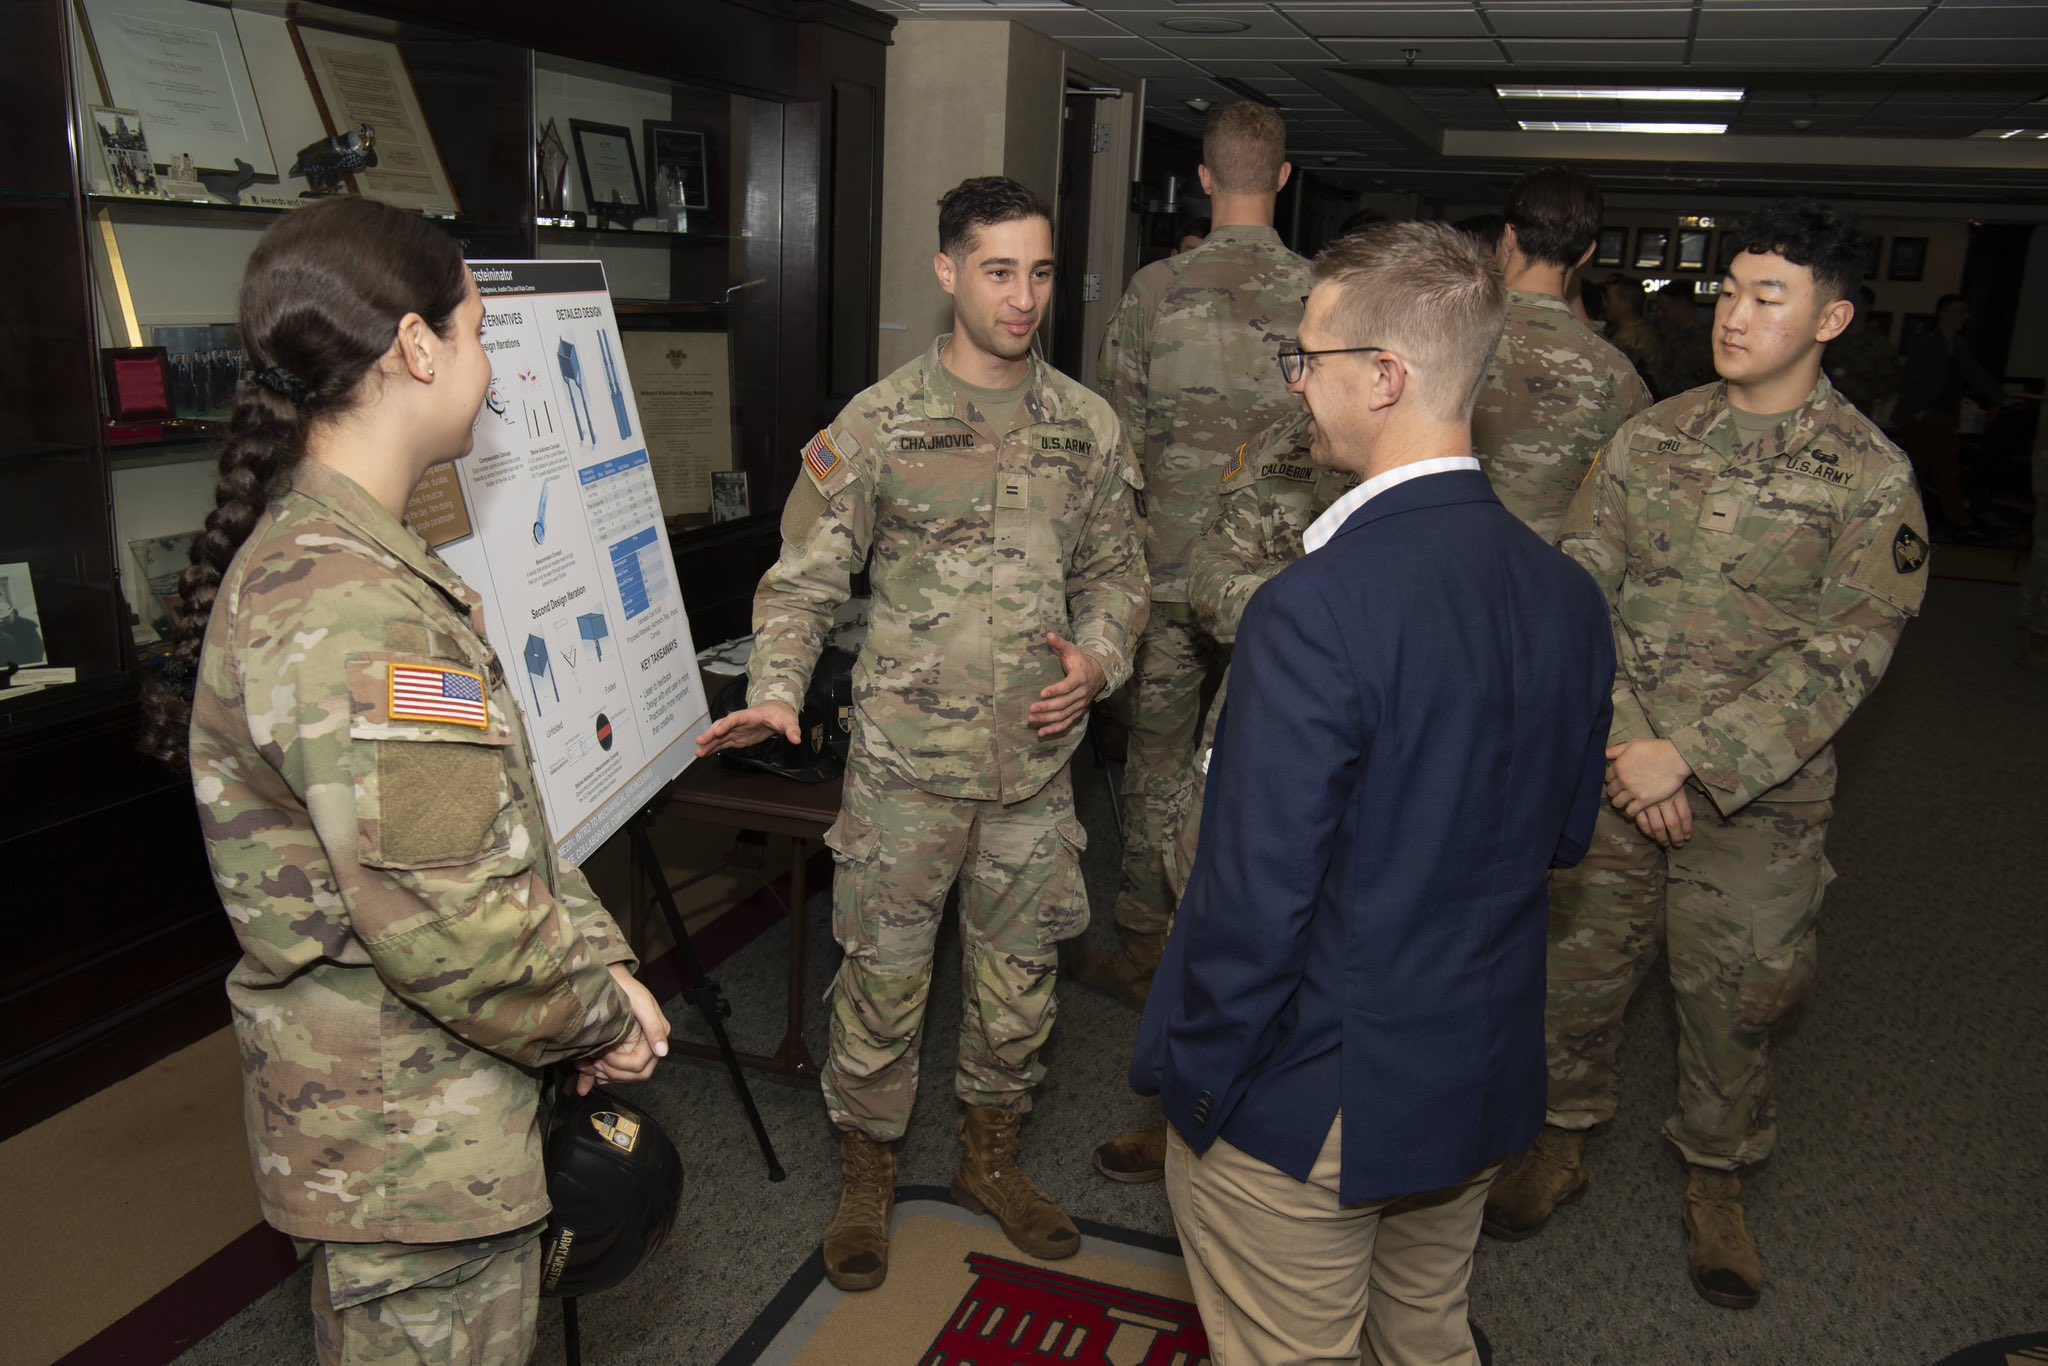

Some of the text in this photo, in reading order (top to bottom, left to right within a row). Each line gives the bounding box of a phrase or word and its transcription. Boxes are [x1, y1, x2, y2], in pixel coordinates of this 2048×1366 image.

[557, 307, 602, 320] DETAILED DESIGN
[496, 338, 520, 349] Iterations
[900, 433, 974, 450] CHAJMOVIC
[1041, 436, 1092, 456] U.S.ARMY
[1658, 438, 1681, 452] CHU
[1261, 463, 1313, 480] CALDERON
[1786, 456, 1855, 485] U.S.ARMY
[531, 585, 586, 620] Second Design Iteration
[641, 640, 678, 672] KEY TAKEAWAYS
[605, 682, 616, 694] Folded
[643, 686, 654, 698] Listen
[657, 672, 672, 688] feedback
[646, 697, 658, 712] Design
[546, 722, 563, 739] Unfolded
[576, 825, 591, 842] INTRO
[598, 794, 628, 822] MECHANICAL
[557, 1229, 574, 1256] ARMY
[549, 1255, 567, 1278] WEST
